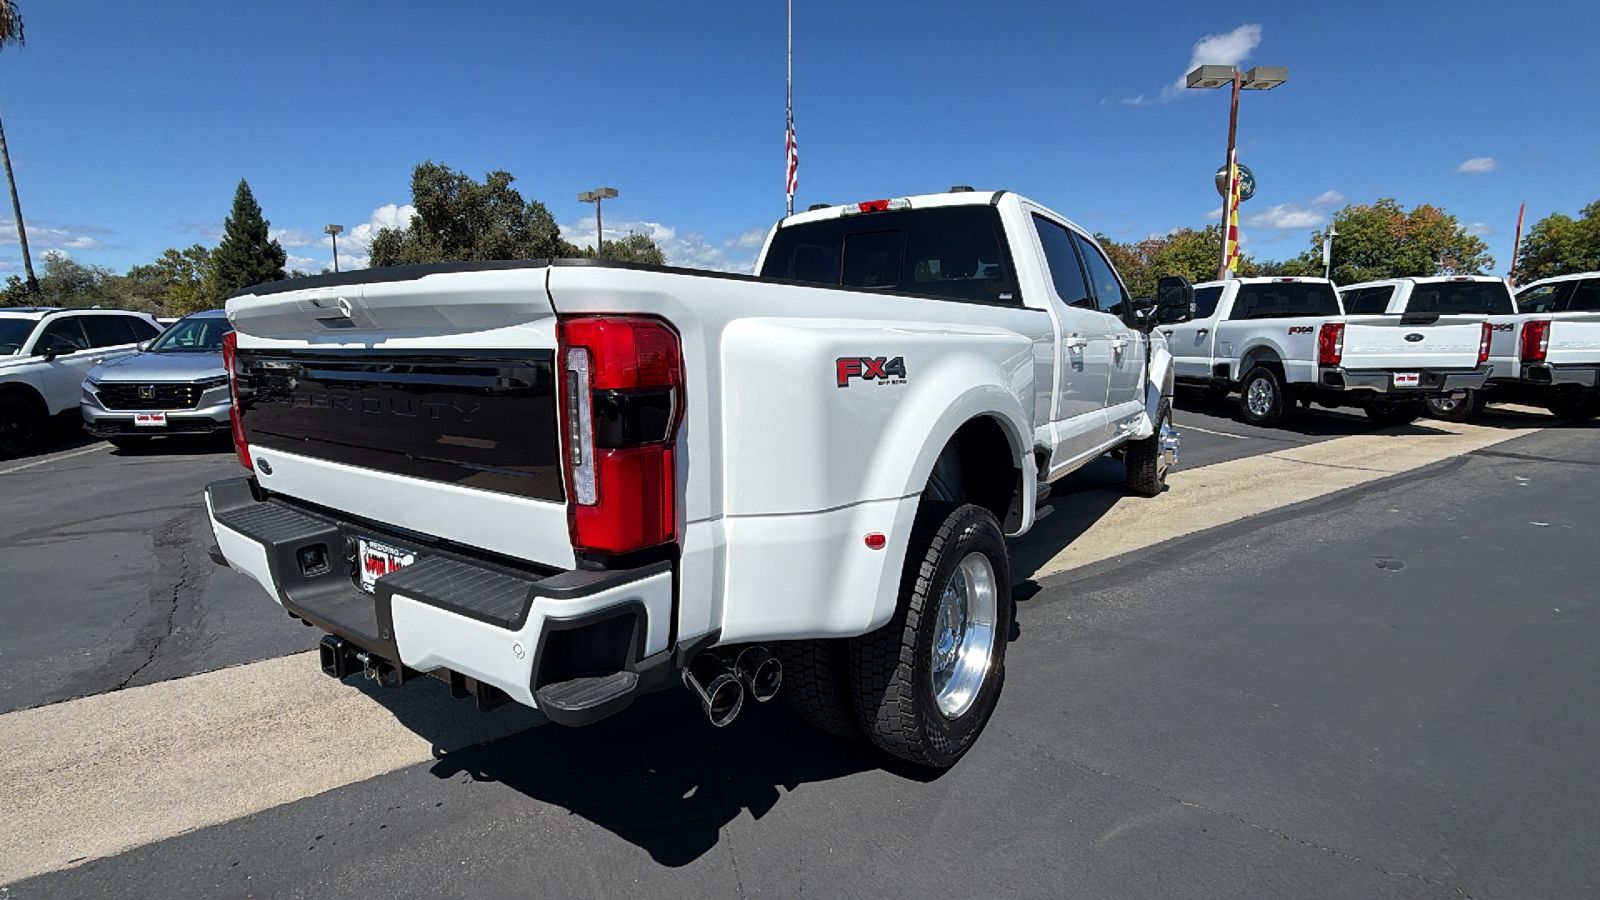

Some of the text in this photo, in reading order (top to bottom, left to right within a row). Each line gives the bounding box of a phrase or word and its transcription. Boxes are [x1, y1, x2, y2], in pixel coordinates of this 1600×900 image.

[1288, 326, 1314, 335] FX4
[1493, 323, 1514, 331] X4
[836, 356, 907, 388] FX4
[257, 386, 481, 423] SUPER DUTY
[369, 541, 399, 556] REDDING
